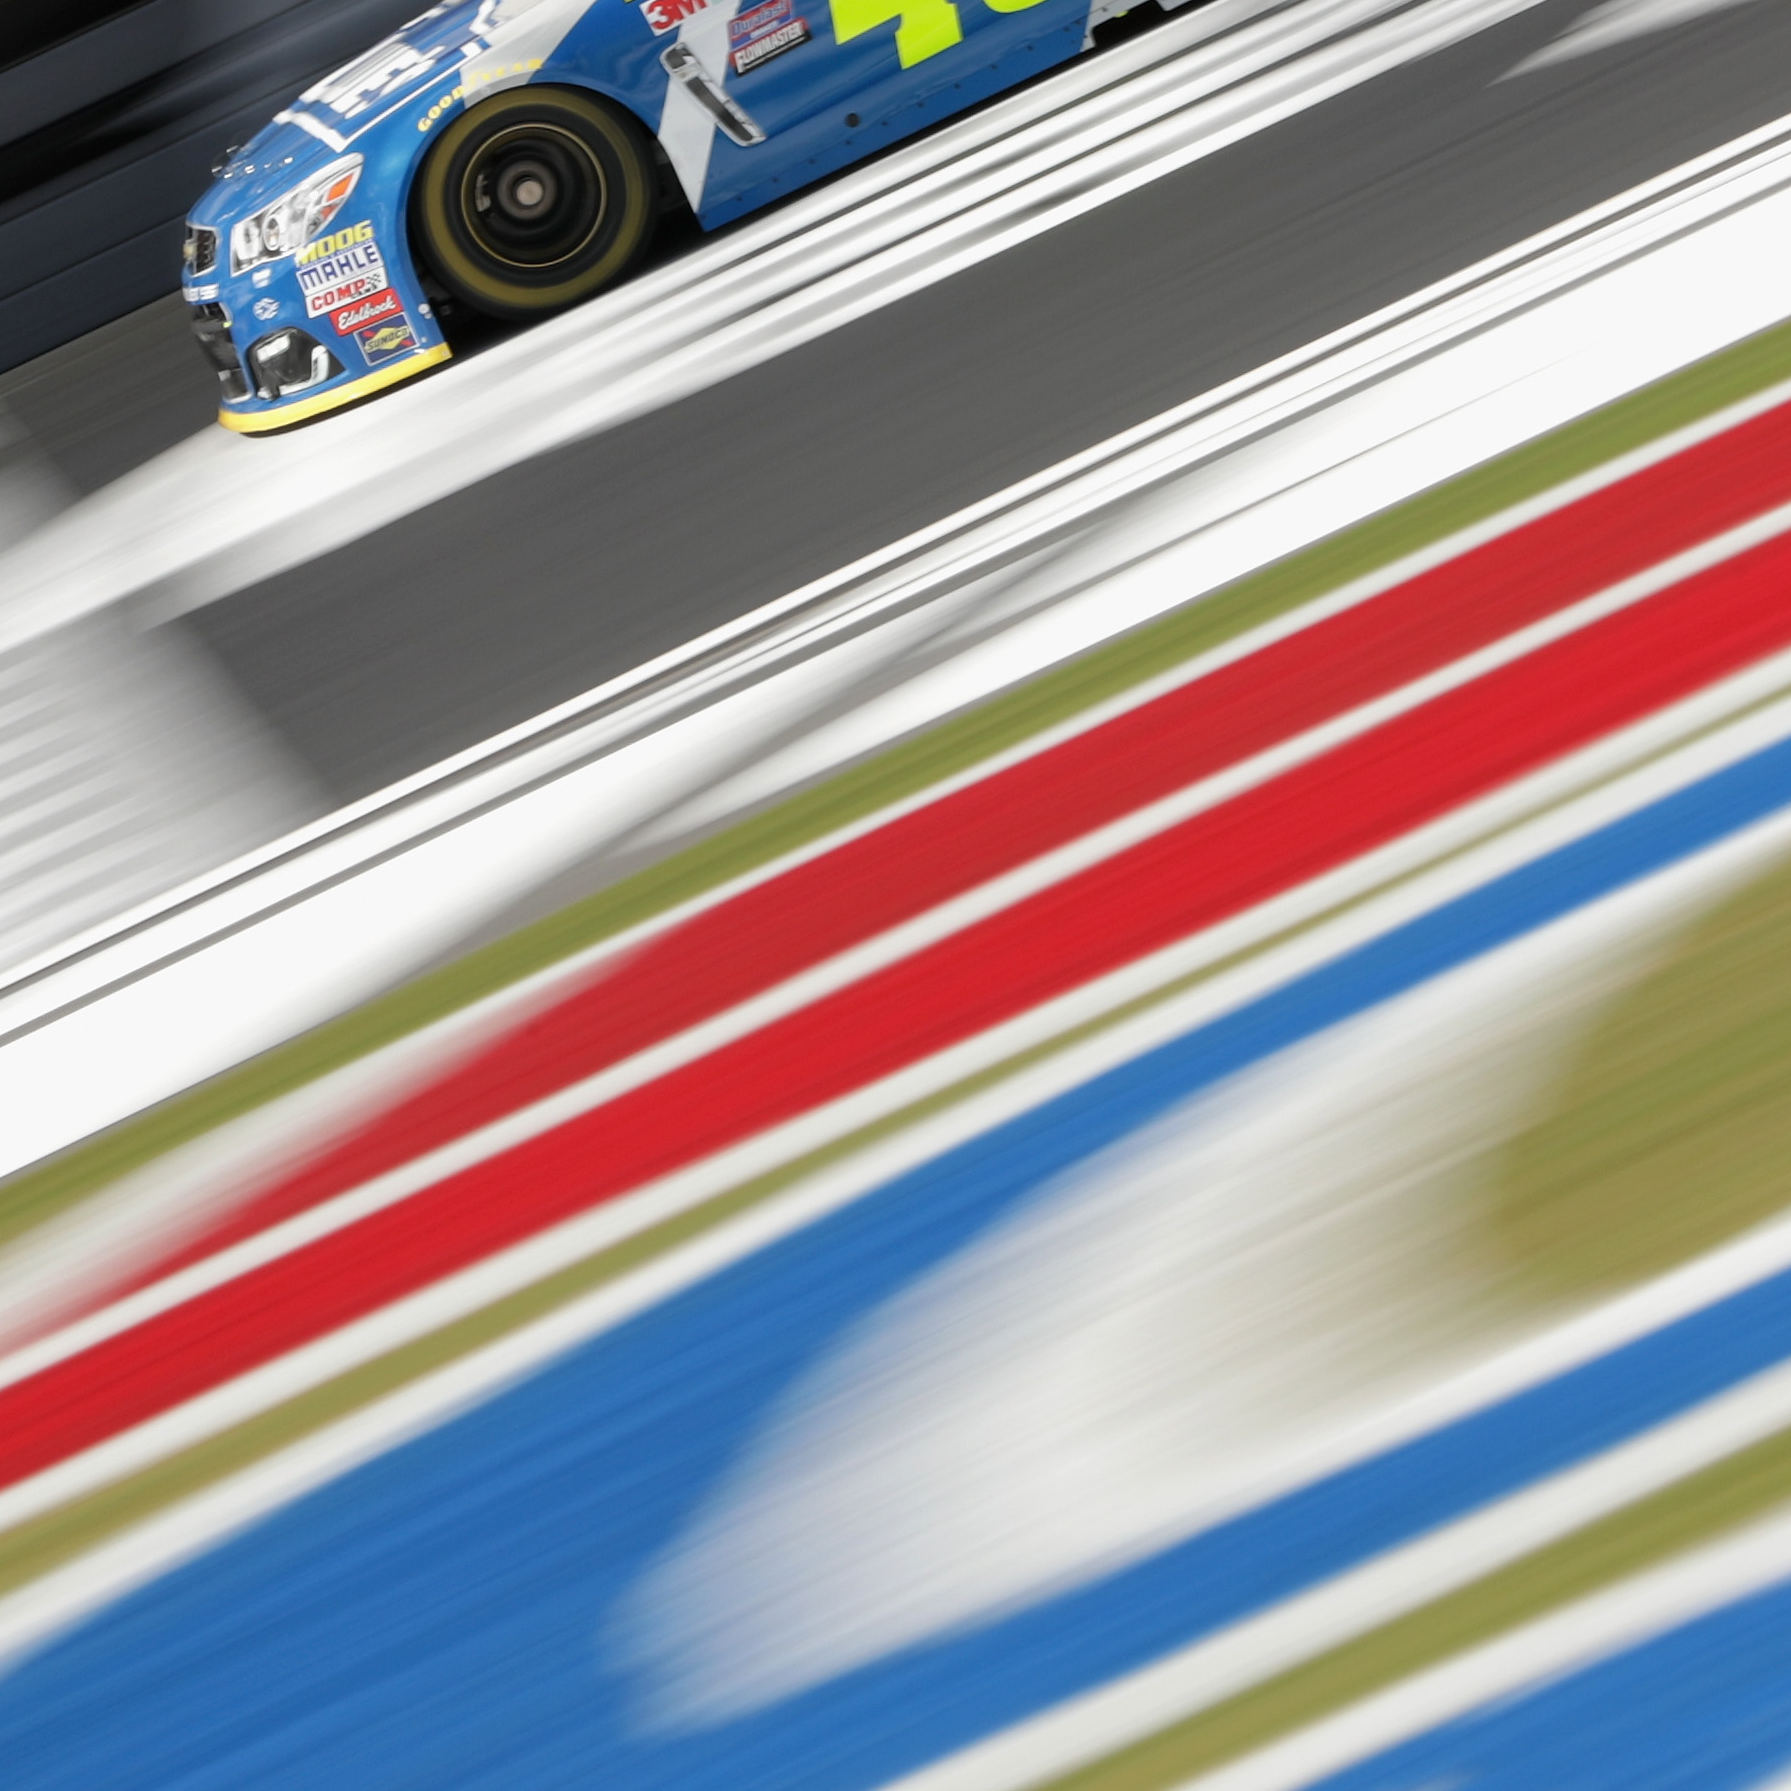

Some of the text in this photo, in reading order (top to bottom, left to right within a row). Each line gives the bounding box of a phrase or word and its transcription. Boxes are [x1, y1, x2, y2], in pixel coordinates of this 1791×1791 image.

[733, 21, 805, 74] FLOWMASTER
[293, 219, 375, 268] MOOG
[300, 245, 380, 291] MAHLE
[311, 278, 367, 311] COMP
[337, 294, 398, 331] Edelbrock
[365, 325, 410, 353] SUNOCO
